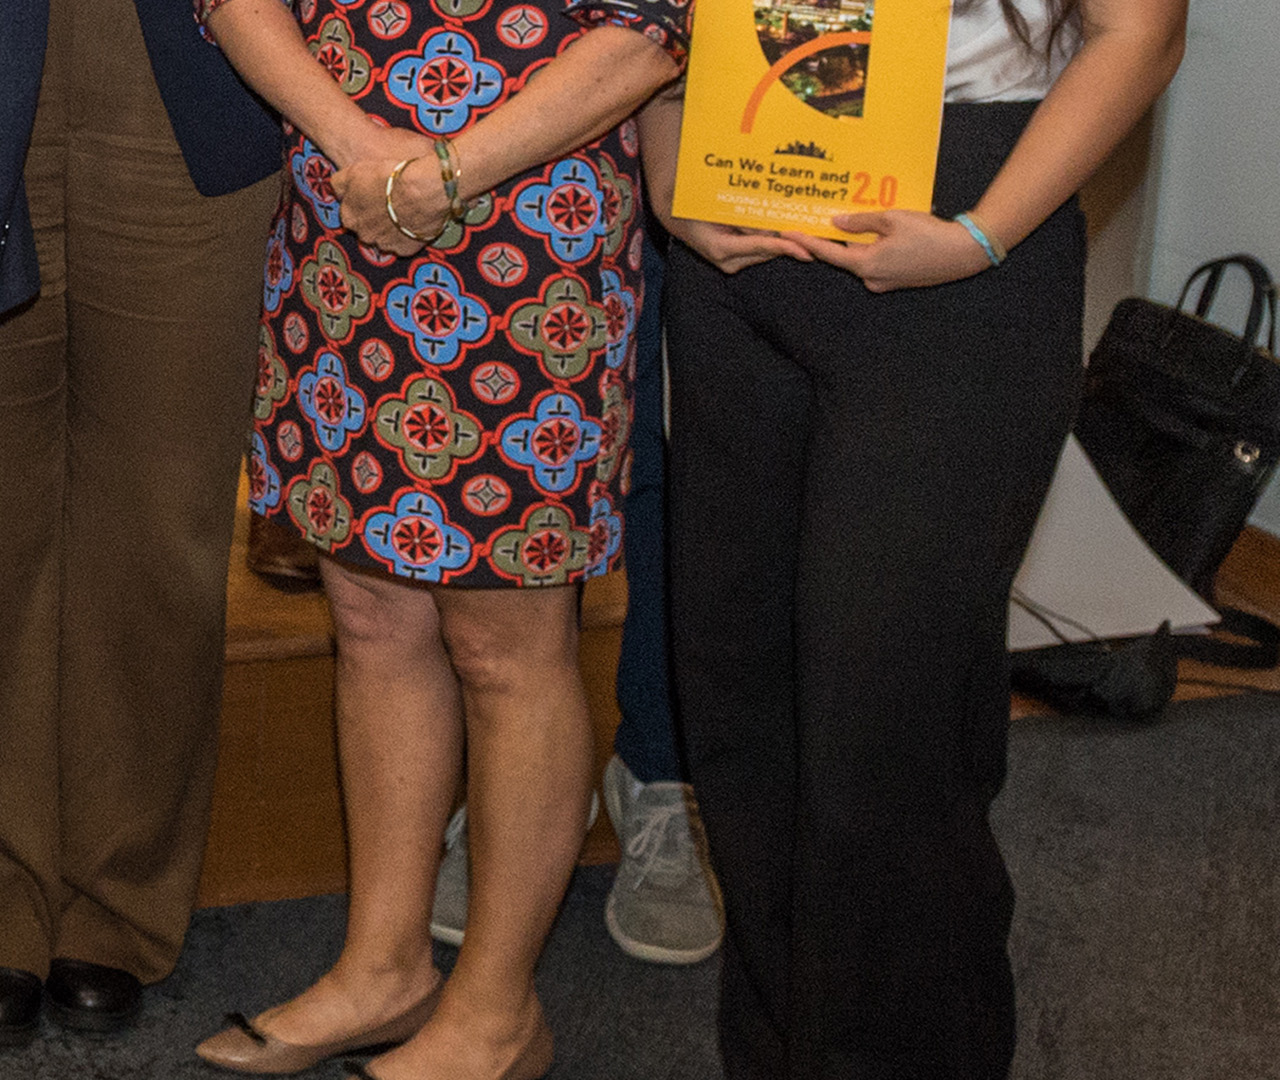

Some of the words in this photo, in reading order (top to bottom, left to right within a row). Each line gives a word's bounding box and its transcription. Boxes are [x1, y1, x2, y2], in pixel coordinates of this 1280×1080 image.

[704, 153, 733, 168] Can
[739, 158, 764, 172] We
[770, 163, 815, 179] Learn
[820, 171, 850, 184] and
[728, 173, 761, 190] Live
[766, 178, 848, 200] Together?
[851, 171, 899, 208] 2.0
